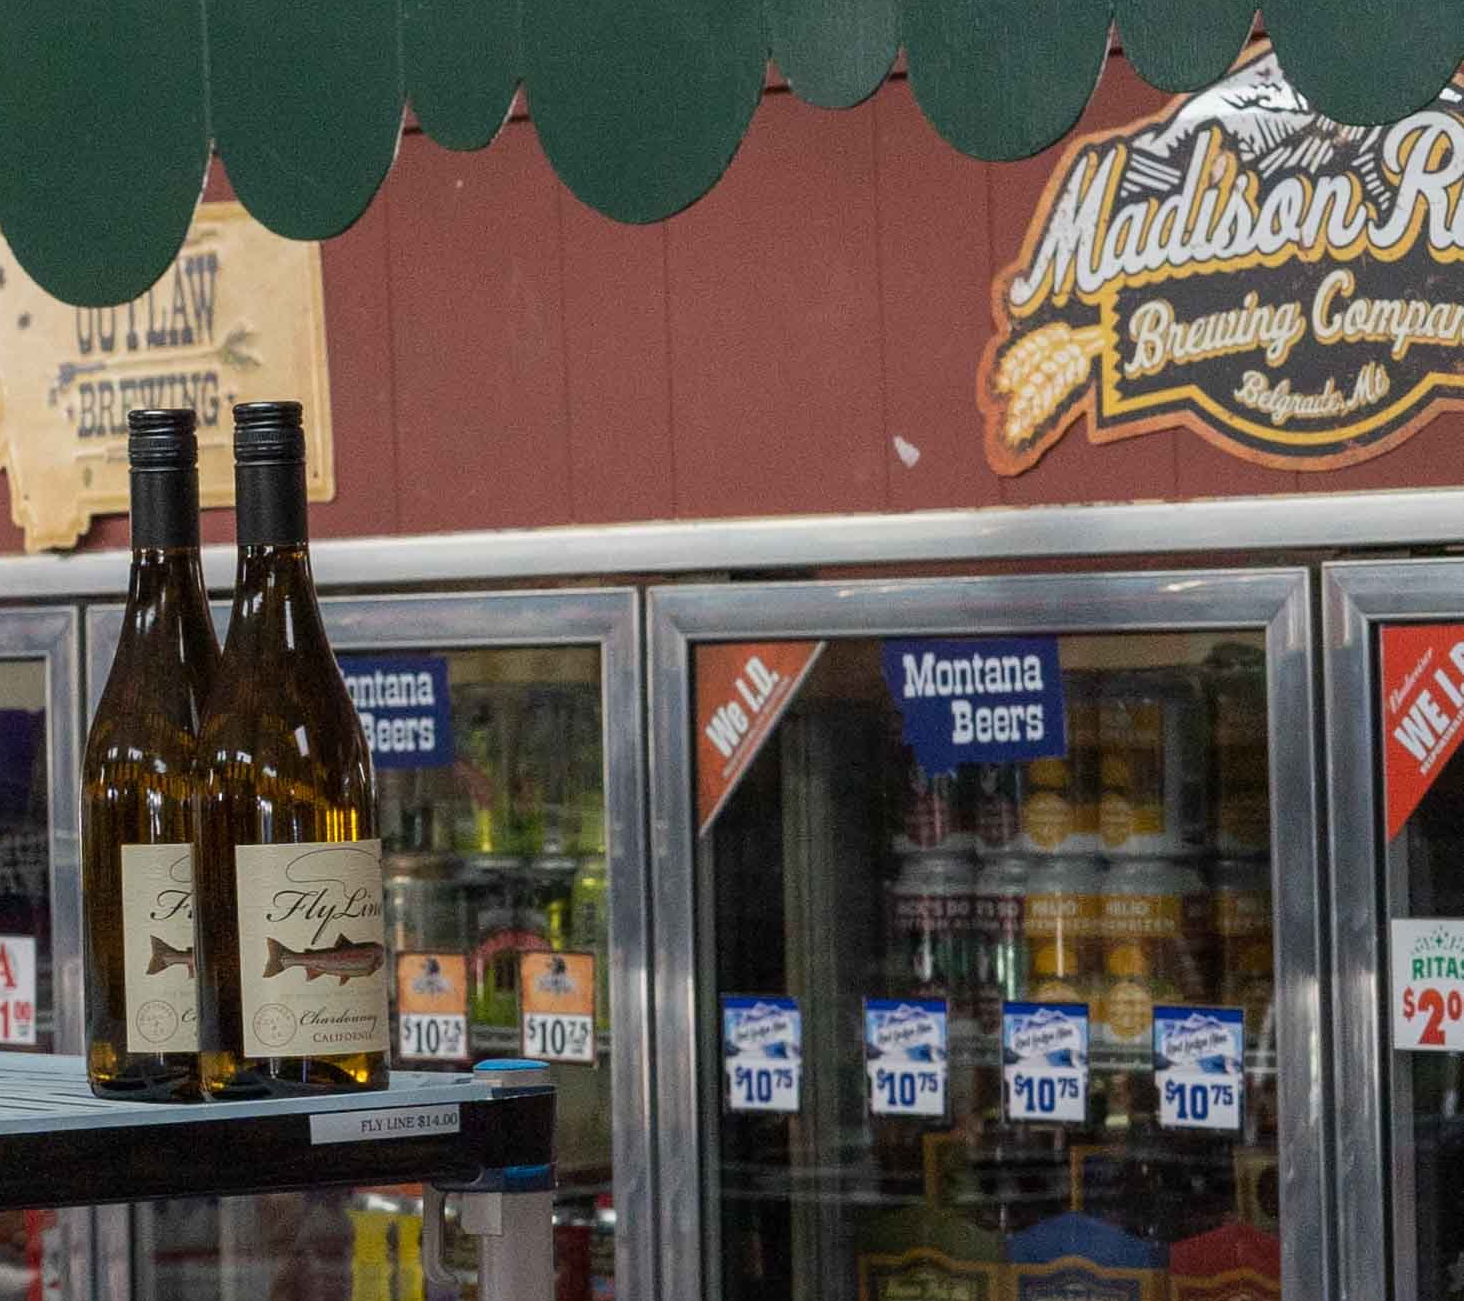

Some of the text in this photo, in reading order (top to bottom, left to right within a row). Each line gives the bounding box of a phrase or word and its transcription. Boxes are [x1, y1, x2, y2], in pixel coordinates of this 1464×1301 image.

[1009, 128, 1368, 306] Madison
[1124, 268, 1464, 380] Brewing Compan
[348, 668, 434, 708] ontana
[902, 651, 1044, 697] Montana
[704, 655, 780, 759] We I.D.
[952, 700, 1045, 745] Beers
[364, 710, 435, 752] Beers
[1394, 710, 1444, 766] WE
[361, 1111, 458, 1132] FLY LINE $14.00
